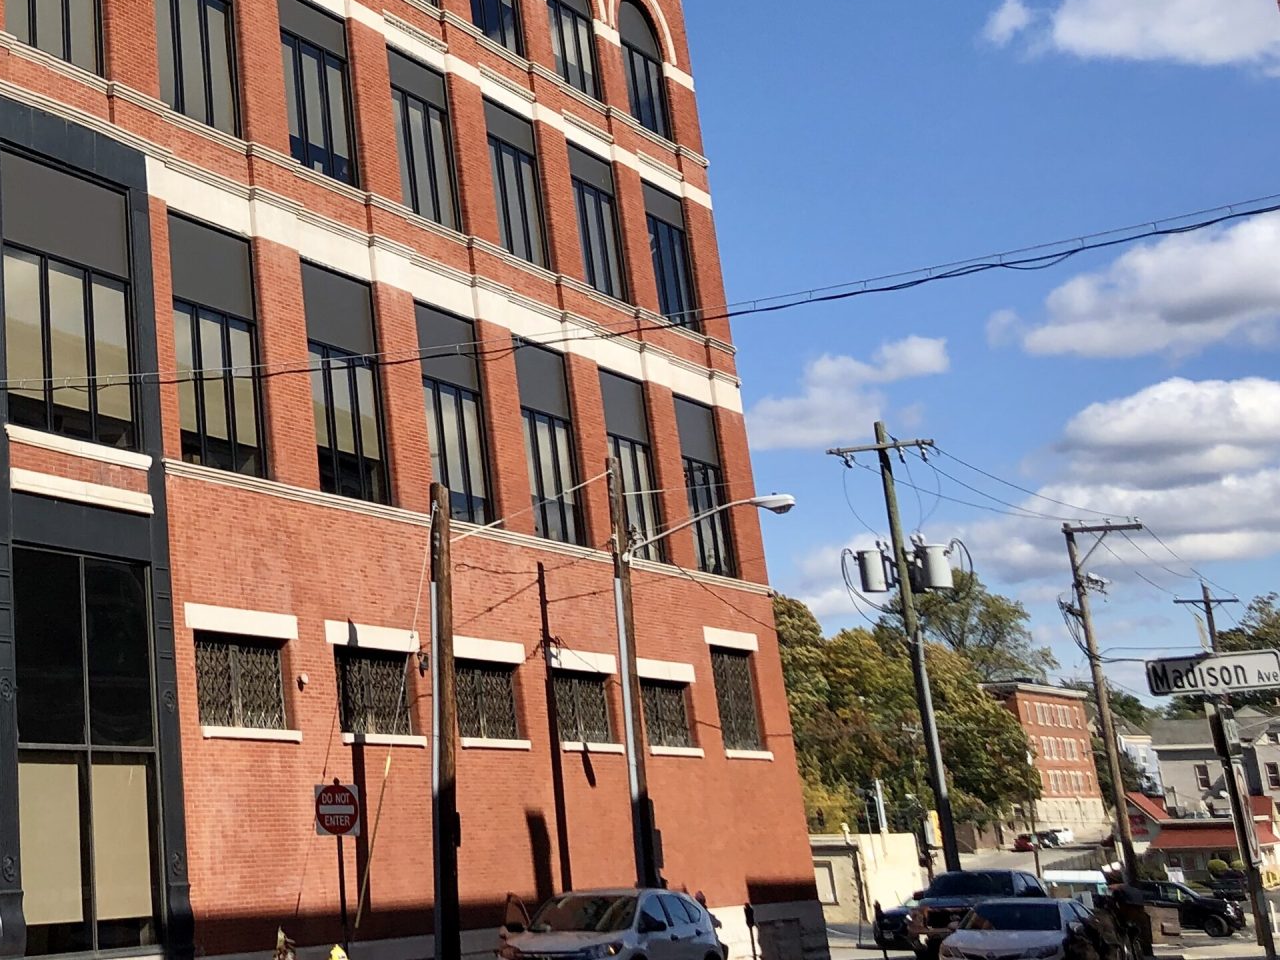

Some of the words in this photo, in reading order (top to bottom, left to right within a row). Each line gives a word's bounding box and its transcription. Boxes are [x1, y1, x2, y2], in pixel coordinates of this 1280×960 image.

[1151, 662, 1248, 692] Madison
[1256, 669, 1280, 683] Ave
[321, 792, 333, 804] DO
[335, 792, 350, 804] NOT
[324, 815, 351, 826] ENTER
